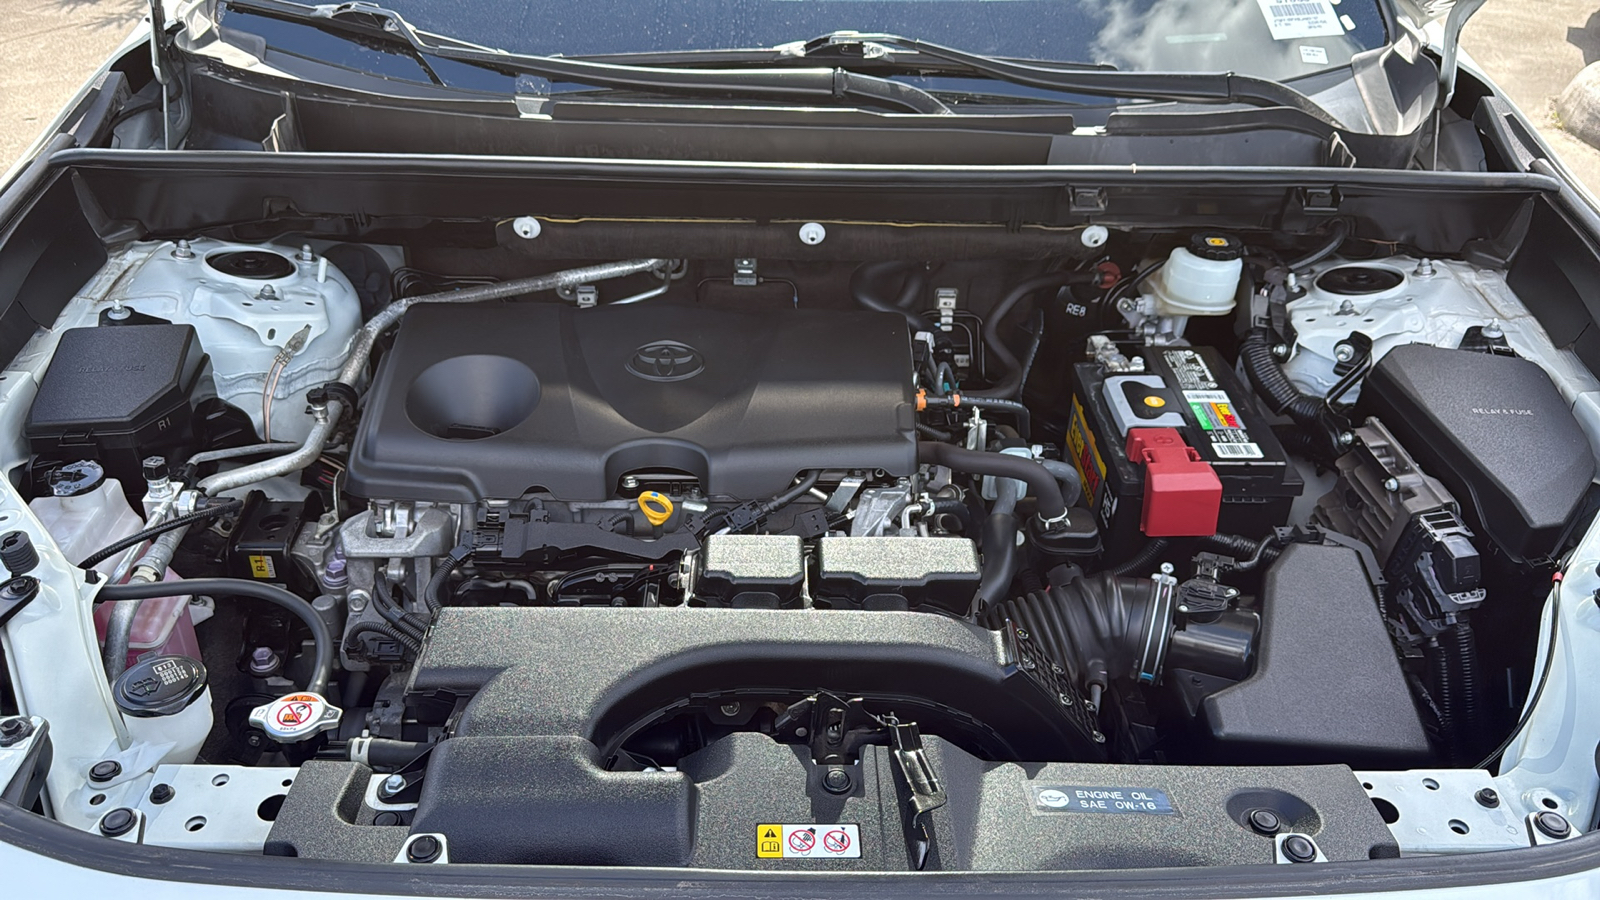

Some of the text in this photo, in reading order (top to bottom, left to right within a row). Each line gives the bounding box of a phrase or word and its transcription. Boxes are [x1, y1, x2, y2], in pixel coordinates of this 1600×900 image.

[157, 417, 171, 430] R1
[254, 559, 266, 572] R1
[1075, 790, 1153, 800] ENGINE OIL
[1080, 800, 1107, 809] SAE
